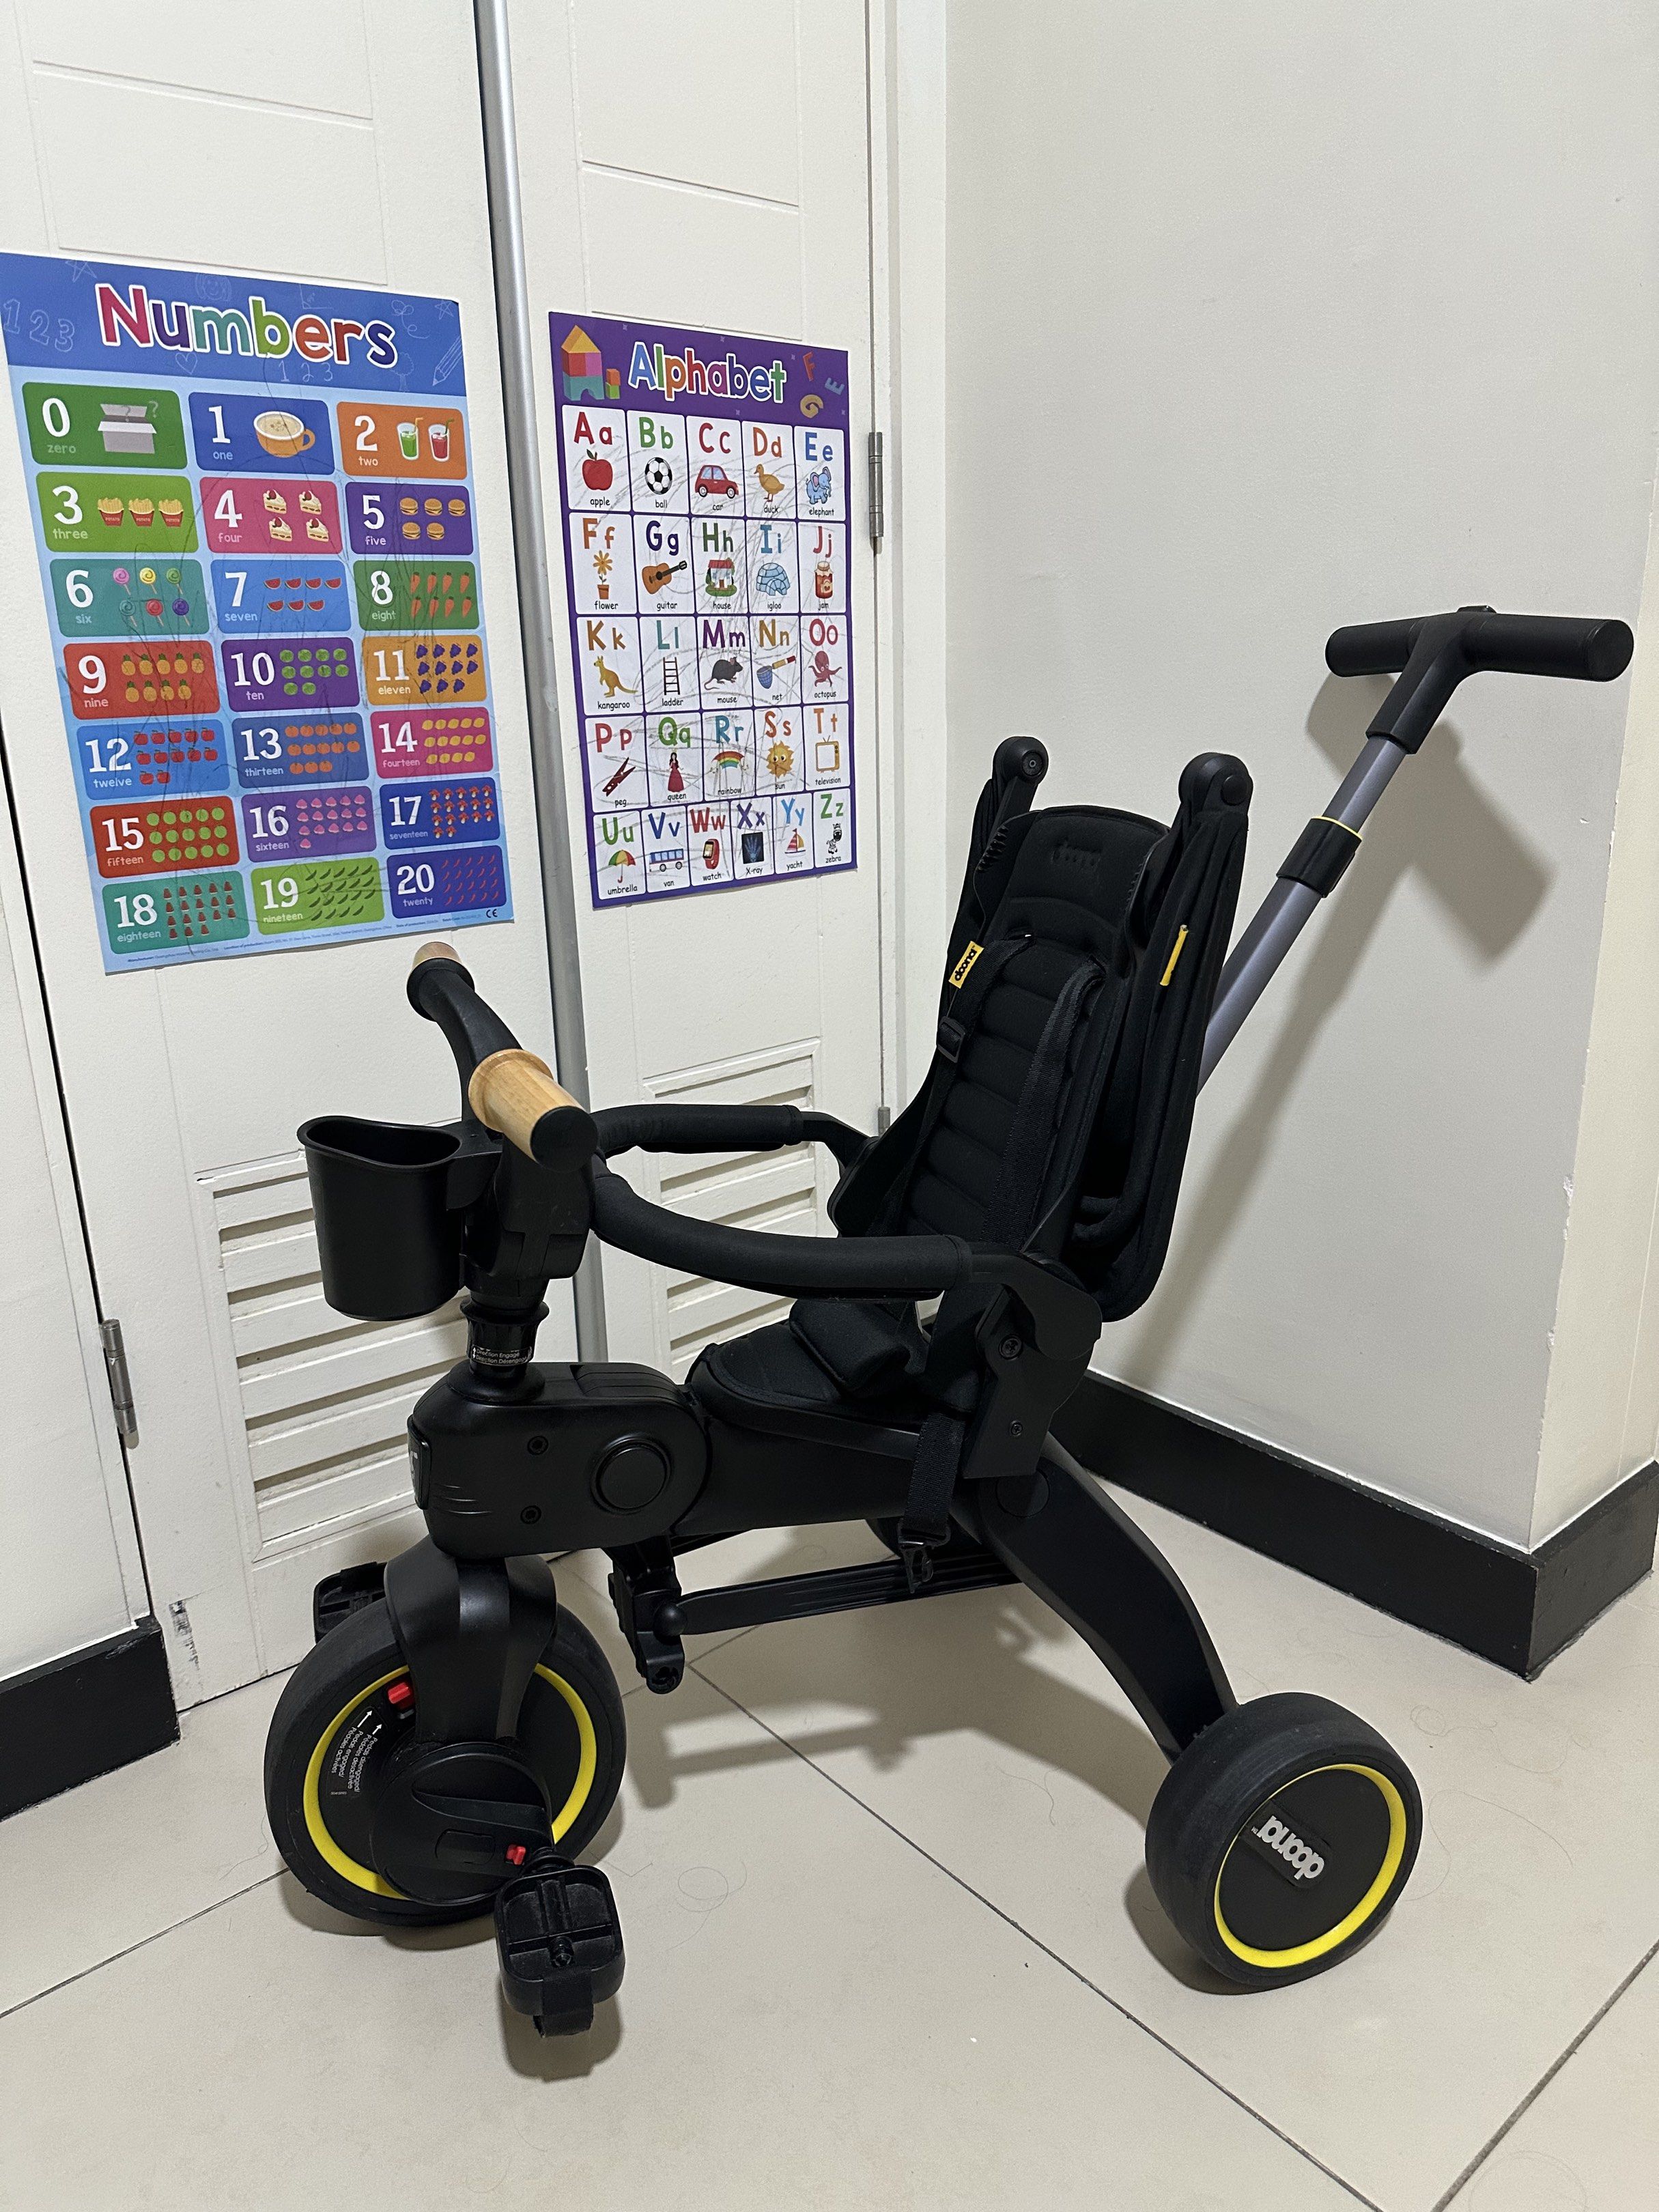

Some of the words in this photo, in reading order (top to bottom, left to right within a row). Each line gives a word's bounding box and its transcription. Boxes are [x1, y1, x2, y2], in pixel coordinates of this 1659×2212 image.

[95, 283, 397, 368] Numbers
[628, 341, 786, 403] Alphabet
[42, 398, 70, 437] 0
[208, 406, 231, 444] 1
[574, 412, 612, 444] Aa
[354, 415, 378, 451] 2
[639, 417, 674, 449] Bb
[699, 423, 731, 454] Cc
[753, 427, 782, 457] Dd
[805, 431, 833, 462] Ee
[47, 444, 76, 453] zero
[213, 451, 233, 460] one
[358, 457, 378, 466] two
[53, 485, 83, 524] 3
[214, 490, 243, 528] 4
[363, 494, 385, 530] 5
[591, 496, 610, 507] apple
[655, 500, 667, 508] ball
[764, 505, 778, 513] duck
[809, 508, 834, 517] elephant
[53, 528, 88, 539] three
[218, 533, 242, 542] four
[365, 536, 386, 545] five
[582, 517, 615, 549] Ff
[646, 520, 679, 556] Gg
[703, 522, 733, 552] Hh
[760, 524, 782, 554] Ii
[812, 526, 832, 558] Jj
[66, 569, 94, 608] 6
[225, 571, 247, 607] 7
[370, 570, 393, 605] 8
[75, 614, 92, 625] six
[225, 612, 257, 622] seven
[371, 611, 396, 622] eight
[595, 601, 618, 610] flower
[657, 601, 677, 611] guitar
[767, 601, 782, 611] igloo
[586, 620, 626, 651] Kk
[657, 620, 679, 650] Ll
[703, 619, 746, 649] Mm
[758, 619, 789, 648] Nn
[809, 618, 838, 647] Oo
[78, 655, 107, 694] 9
[231, 653, 274, 686] 10
[373, 650, 410, 681] 11
[84, 698, 109, 708] nine
[246, 690, 264, 700] ten
[378, 685, 411, 695] eleven
[662, 698, 683, 707] ladder
[814, 691, 836, 699] octopus
[597, 701, 630, 711] kangaroo
[658, 717, 691, 748] Qq
[715, 715, 743, 743] Rr
[765, 711, 791, 738] Ss
[813, 708, 838, 734] Tt
[240, 728, 282, 761] 13
[378, 722, 418, 754] 14
[595, 723, 632, 752] Pp
[85, 738, 132, 773] 12
[382, 758, 420, 768] fourteen
[93, 778, 132, 789] twelve
[244, 767, 284, 777] thirteen
[815, 777, 841, 785] television
[615, 799, 627, 808] peg
[667, 793, 687, 801] queen
[718, 787, 742, 795] rainbow
[388, 795, 422, 826] 17
[737, 802, 765, 830] Xx
[781, 797, 804, 826] Yy
[821, 793, 844, 819] Zz
[102, 817, 143, 852] 15
[250, 806, 289, 838] 16
[602, 817, 634, 845] Uu
[648, 812, 681, 840] Vv
[690, 807, 726, 834] Ww
[255, 842, 289, 851] sixteen
[389, 830, 428, 840] seventeen
[107, 855, 143, 867] fifteen
[746, 867, 763, 875] X-ray
[786, 861, 803, 871] yacht
[825, 855, 842, 864] zebra
[397, 864, 435, 896] 20
[608, 884, 638, 895] umbrella
[703, 873, 722, 881] watch
[260, 877, 298, 910] 19
[403, 897, 434, 908] twenty
[114, 894, 157, 928] 18
[263, 912, 303, 924] nineteen
[117, 930, 162, 943] eighteen
[955, 948, 977, 980] doona
[349, 1730, 363, 1749] Pedals
[363, 1737, 378, 1756] Pedals
[1257, 1815, 1324, 1880] doona
